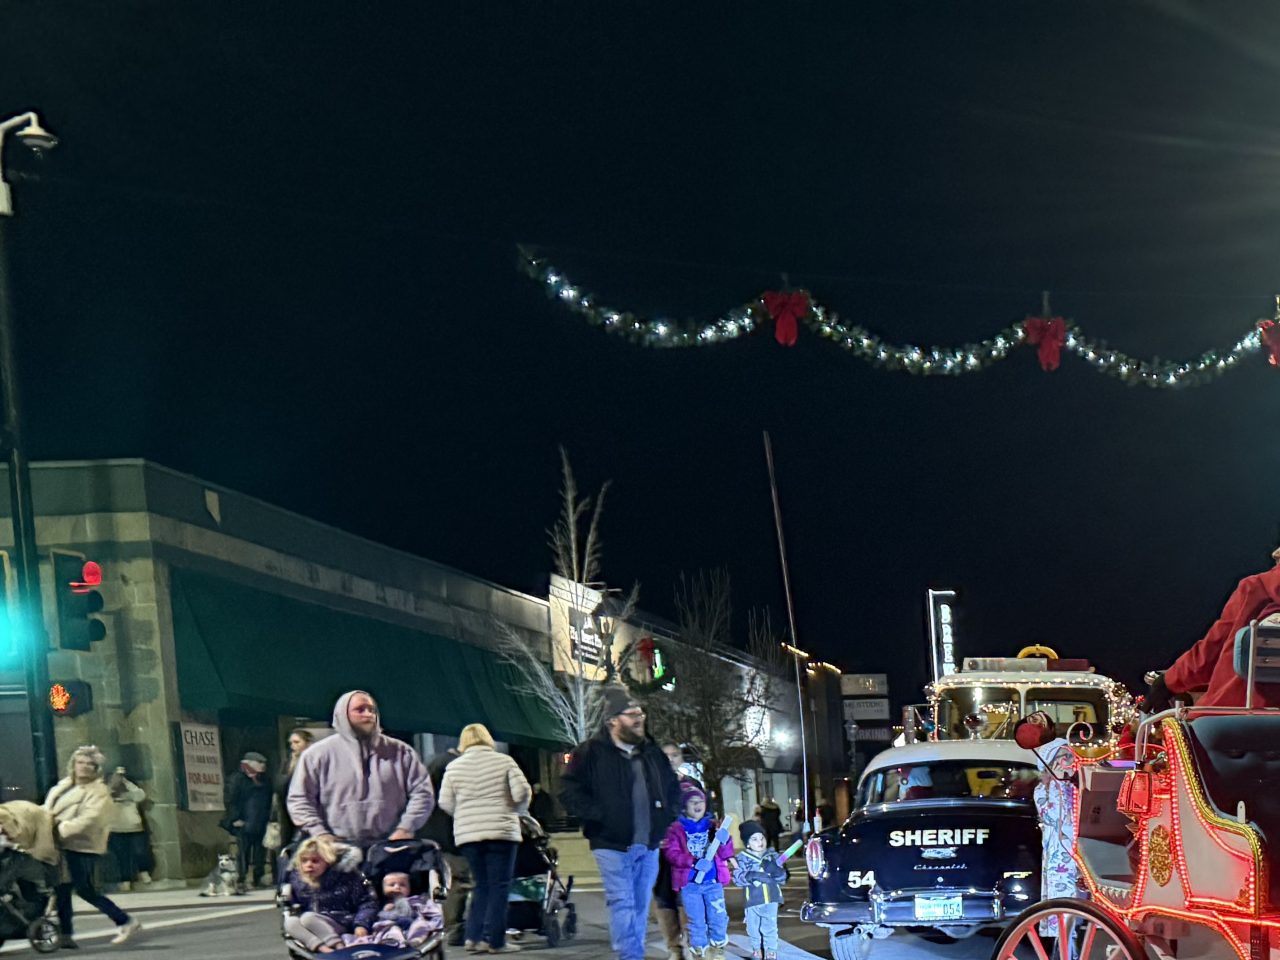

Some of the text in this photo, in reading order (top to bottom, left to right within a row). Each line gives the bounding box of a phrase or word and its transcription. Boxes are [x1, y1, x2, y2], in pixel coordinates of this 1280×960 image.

[183, 729, 216, 746] CHASE
[202, 773, 221, 785] SALE
[889, 828, 990, 846] SHERIFF
[847, 870, 876, 888] 54
